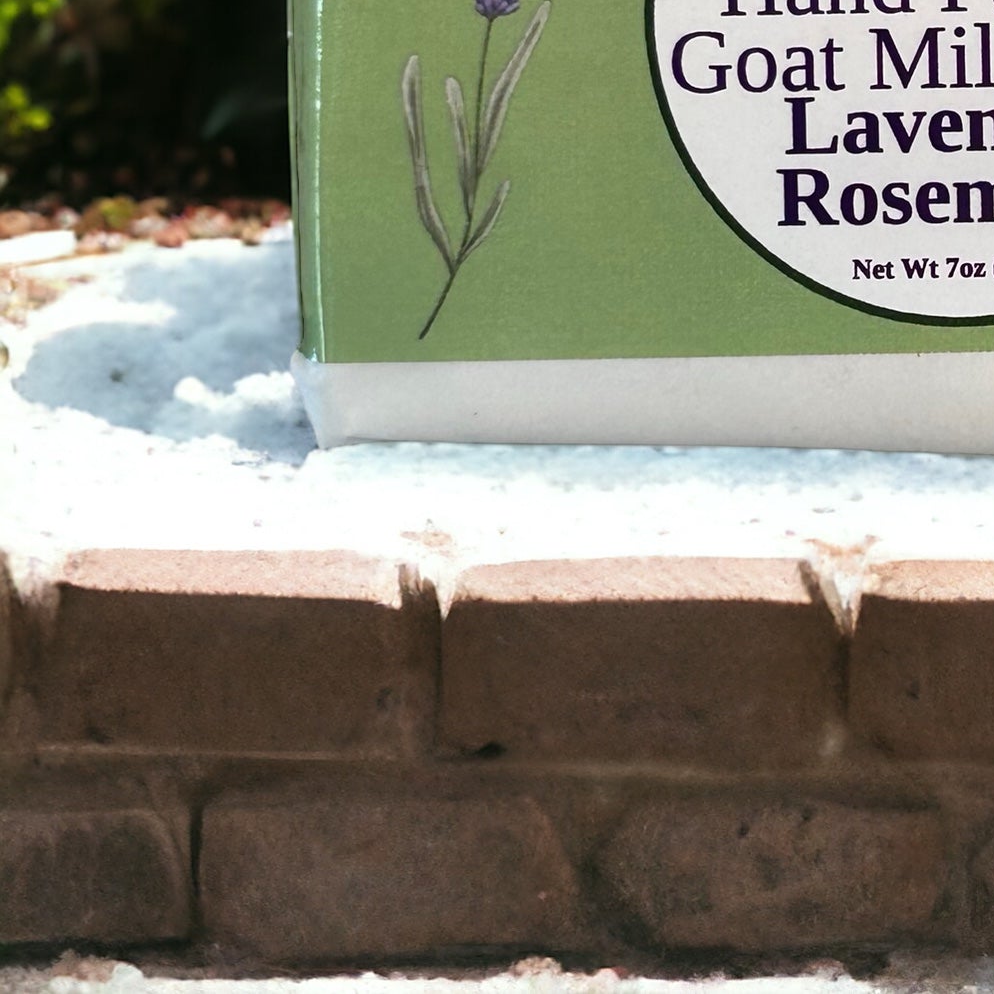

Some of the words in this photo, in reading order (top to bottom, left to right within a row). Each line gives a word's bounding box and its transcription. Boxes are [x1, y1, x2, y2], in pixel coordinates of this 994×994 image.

[671, 32, 845, 93] Goat
[852, 259, 895, 279] Net
[901, 258, 939, 279] Wt
[946, 258, 986, 278] 7oz
